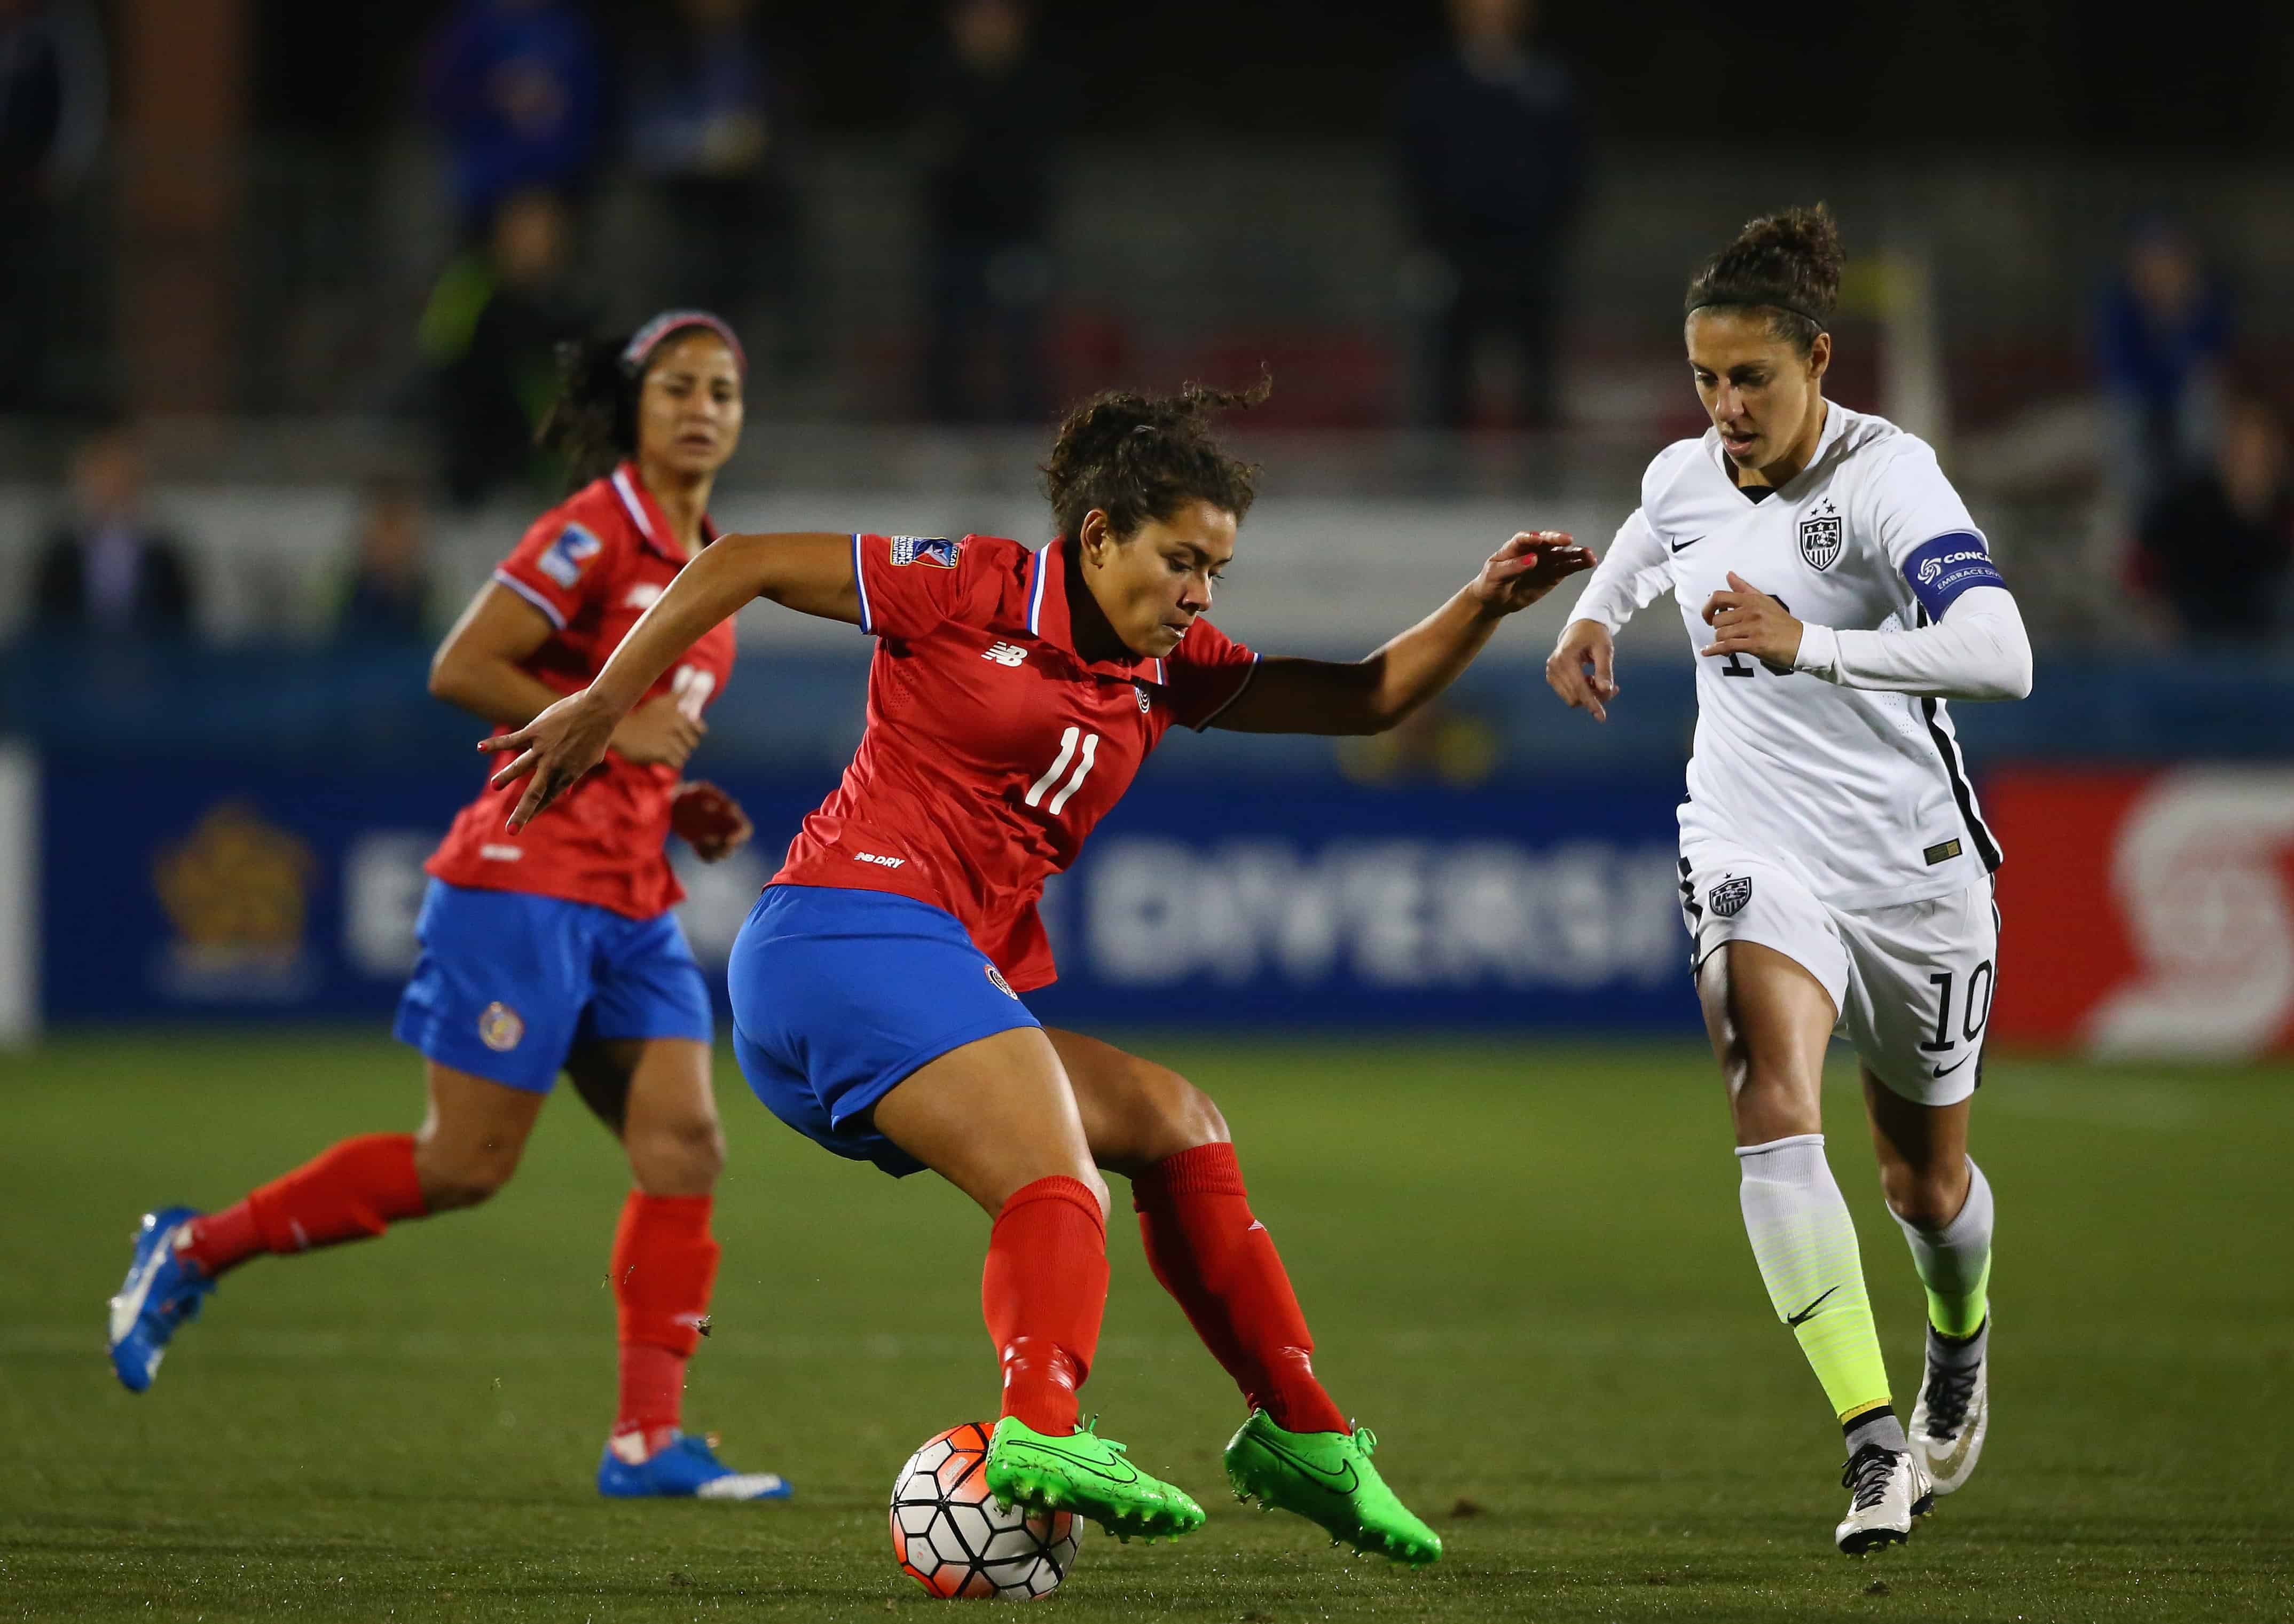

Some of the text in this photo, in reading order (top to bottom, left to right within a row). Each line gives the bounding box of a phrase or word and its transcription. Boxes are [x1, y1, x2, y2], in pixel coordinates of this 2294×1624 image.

[898, 536, 907, 565] OLYMPIC
[1937, 569, 1985, 590] EMBRACE
[1026, 727, 1099, 816] 11
[1920, 959, 1992, 1052] 10
